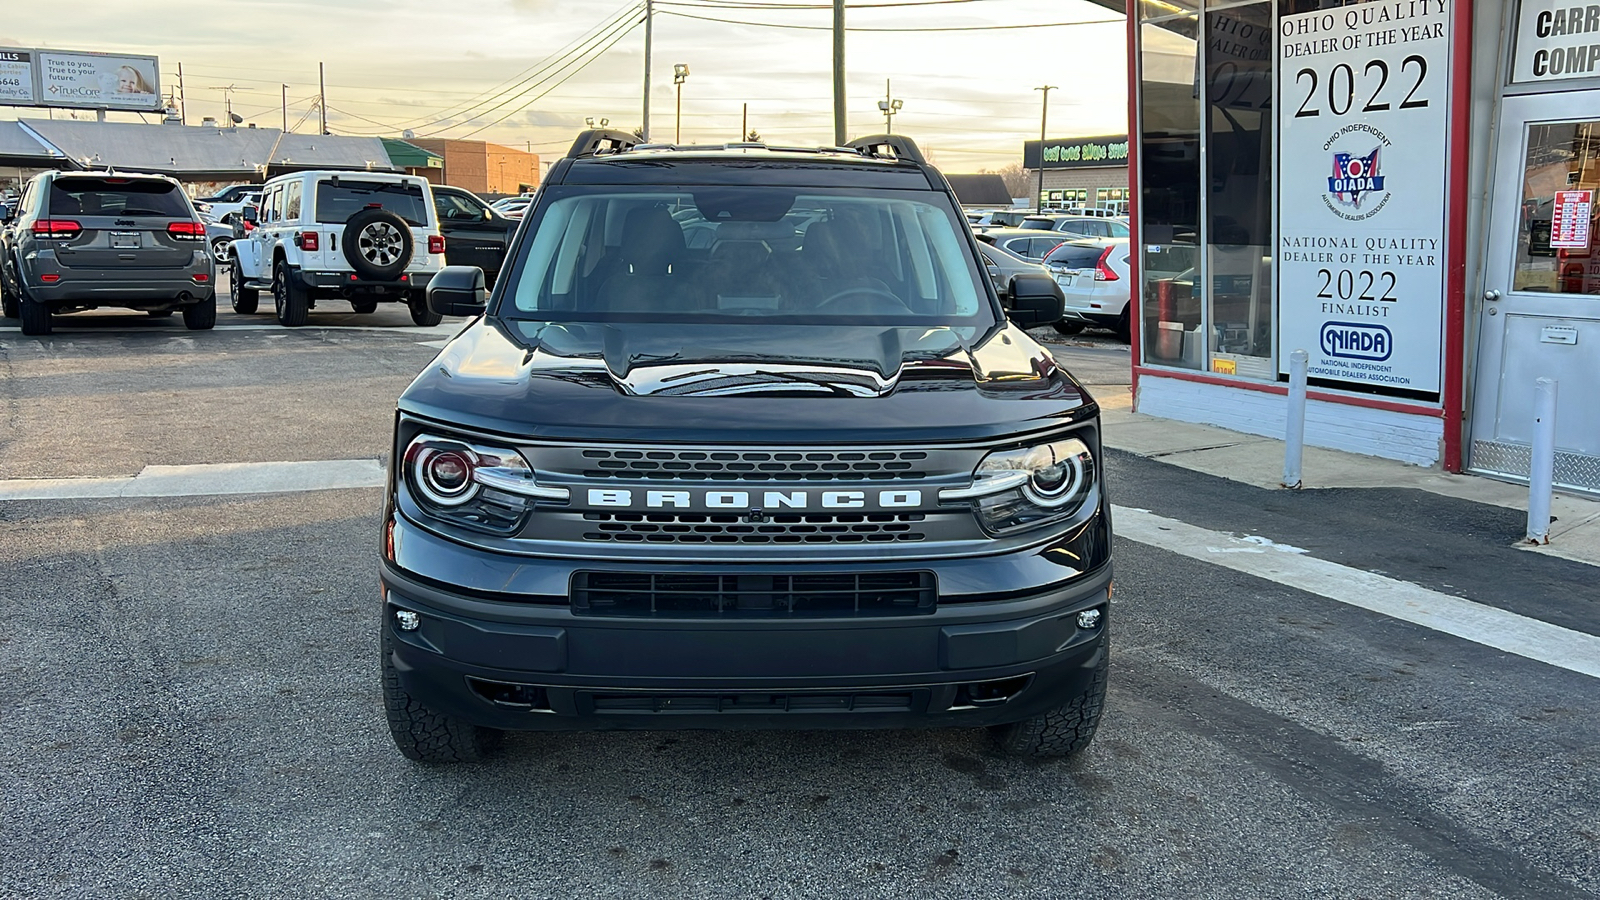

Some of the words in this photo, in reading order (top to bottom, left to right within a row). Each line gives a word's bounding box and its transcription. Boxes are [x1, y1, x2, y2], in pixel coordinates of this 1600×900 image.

[1281, 15, 1335, 37] OHIO
[1345, 0, 1446, 30] QUALITY
[1536, 5, 1600, 38] CARR
[1284, 37, 1339, 58] DEALER
[1342, 34, 1361, 51] OF
[1365, 29, 1397, 48] THE
[1401, 22, 1444, 43] YEAR
[1533, 44, 1600, 77] COMP
[48, 73, 76, 81] future.
[1294, 54, 1429, 118] 2022
[58, 85, 100, 96] TrueCore
[1323, 132, 1340, 151] OHIO
[1340, 123, 1392, 148] INDEPENDENT
[1334, 177, 1375, 192] OIADA
[1321, 193, 1344, 218] AUTOMOBILE
[1344, 213, 1366, 221] DEALERS
[1365, 191, 1391, 219] ASSOCIATION
[114, 219, 136, 228] Jeep
[1282, 236, 1359, 249] NATIONAL
[1365, 237, 1438, 251] QUALITY
[1284, 251, 1334, 263] DEALER
[1340, 252, 1357, 264] OF
[1363, 253, 1390, 265] THE
[1397, 254, 1436, 266] YEAR
[1316, 268, 1398, 303] 2022
[1321, 302, 1390, 318] FINALIST
[1325, 328, 1386, 354] NIADA
[1320, 358, 1350, 369] NATIONAL
[1350, 361, 1392, 373] INDEPENDENT
[1341, 369, 1367, 380] DEALERS
[1367, 372, 1411, 385] ASSOCIATION
[587, 488, 922, 509] BRONCO
